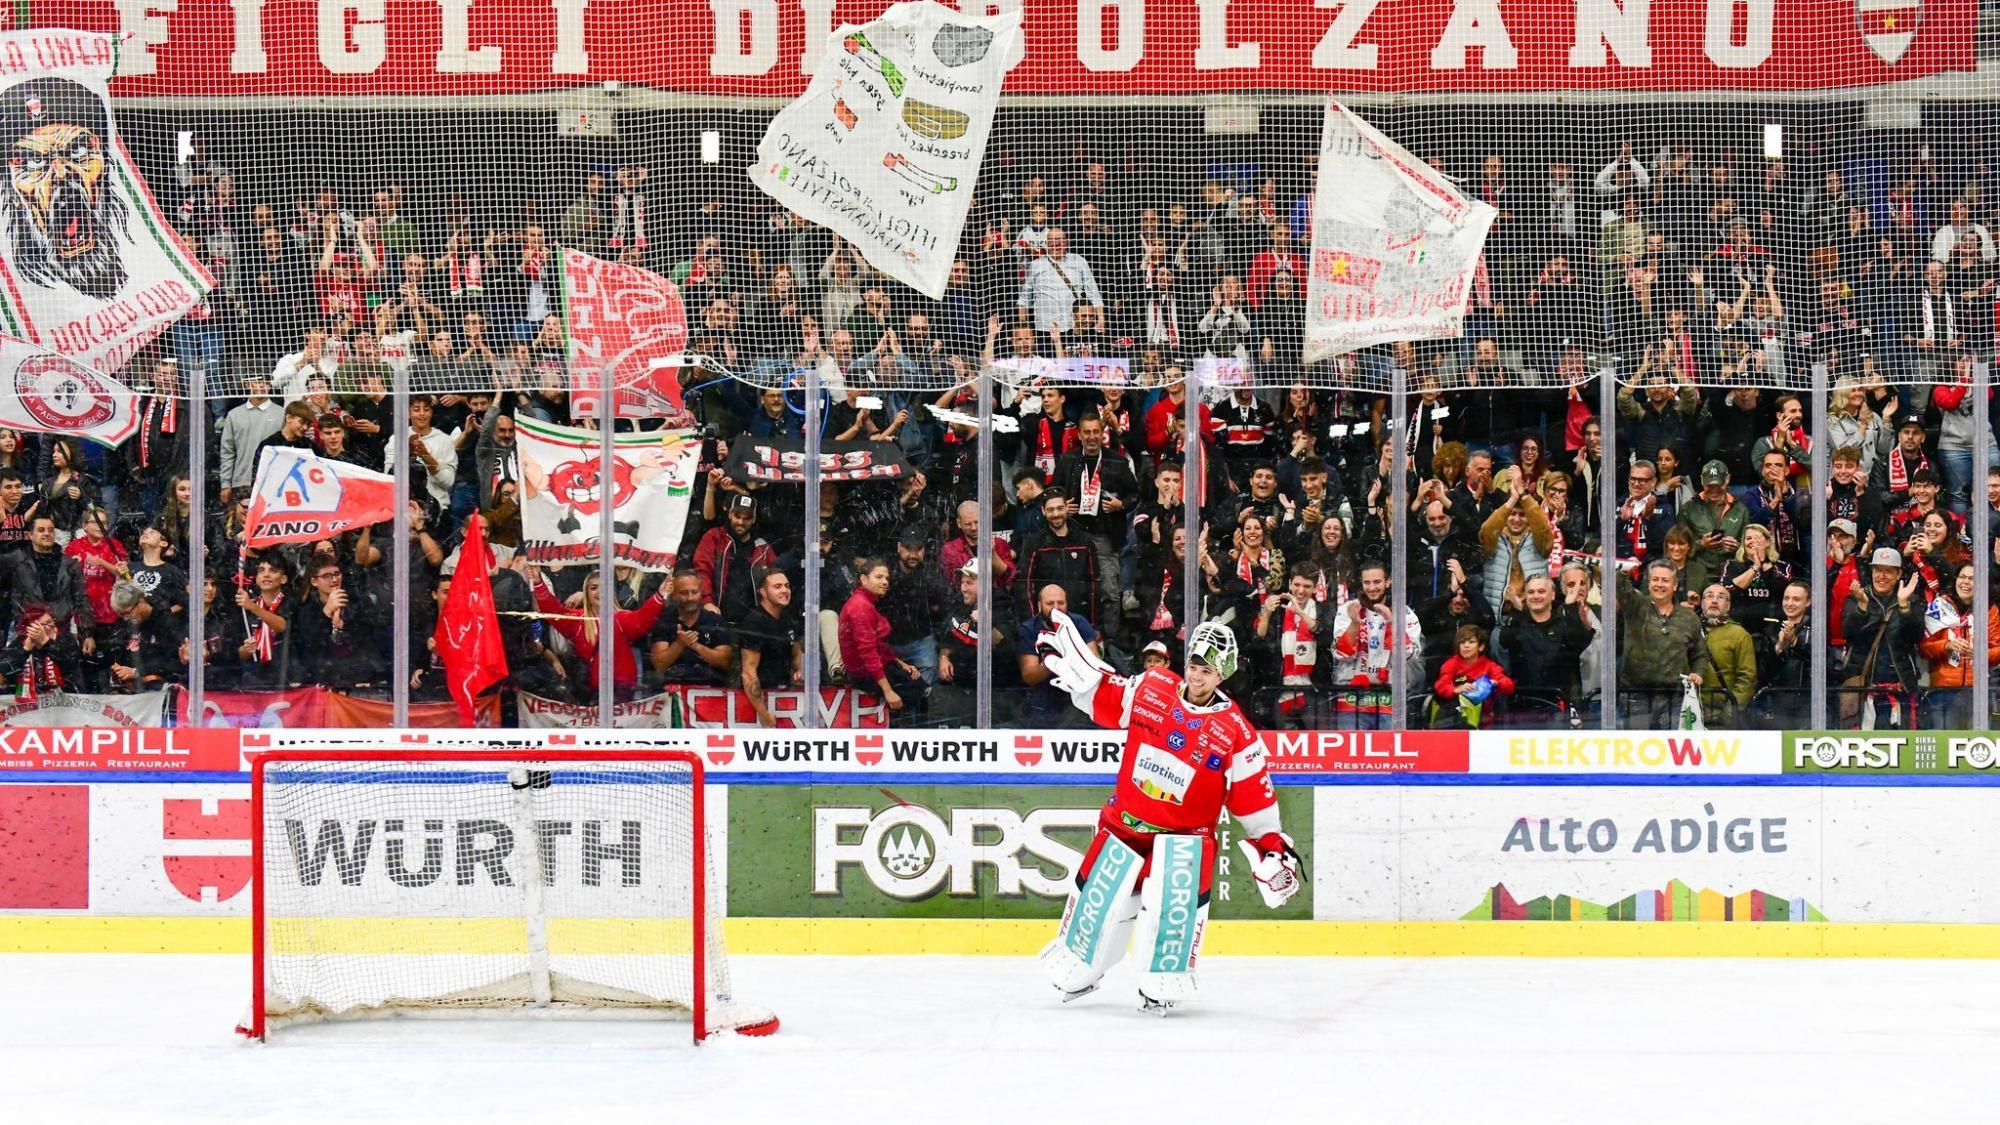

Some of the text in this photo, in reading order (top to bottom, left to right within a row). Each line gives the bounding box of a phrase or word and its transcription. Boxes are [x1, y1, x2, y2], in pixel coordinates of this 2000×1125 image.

[114, 0, 590, 75] FIGLI
[960, 0, 1776, 74] OLZANO
[136, 280, 192, 317] CLUB
[36, 404, 62, 425] PADRE
[78, 410, 106, 427] FIGLIO
[309, 468, 325, 484] C
[285, 491, 302, 506] B
[1748, 588, 1770, 598] 1933
[102, 704, 140, 728] ROS
[524, 698, 665, 718] VECCHI STILE
[0, 729, 190, 755] KAMPILL
[743, 740, 849, 762] WÜRTH
[892, 740, 998, 762] WÜRTH
[1257, 733, 1419, 757] MPILL
[1915, 736, 1936, 744] BIRRA
[1915, 745, 1936, 753] BIERE
[1051, 741, 1124, 763] WÜR
[1794, 736, 1908, 768] FORST
[0, 759, 187, 768] MBISS PIZZERIA RESTAURANT
[1334, 761, 1416, 769] RESTAURANT
[285, 819, 642, 888] WÜRTH
[811, 804, 1102, 898] FORS
[1159, 837, 1194, 972] MICROTEC
[1188, 919, 1204, 969] TRUE
